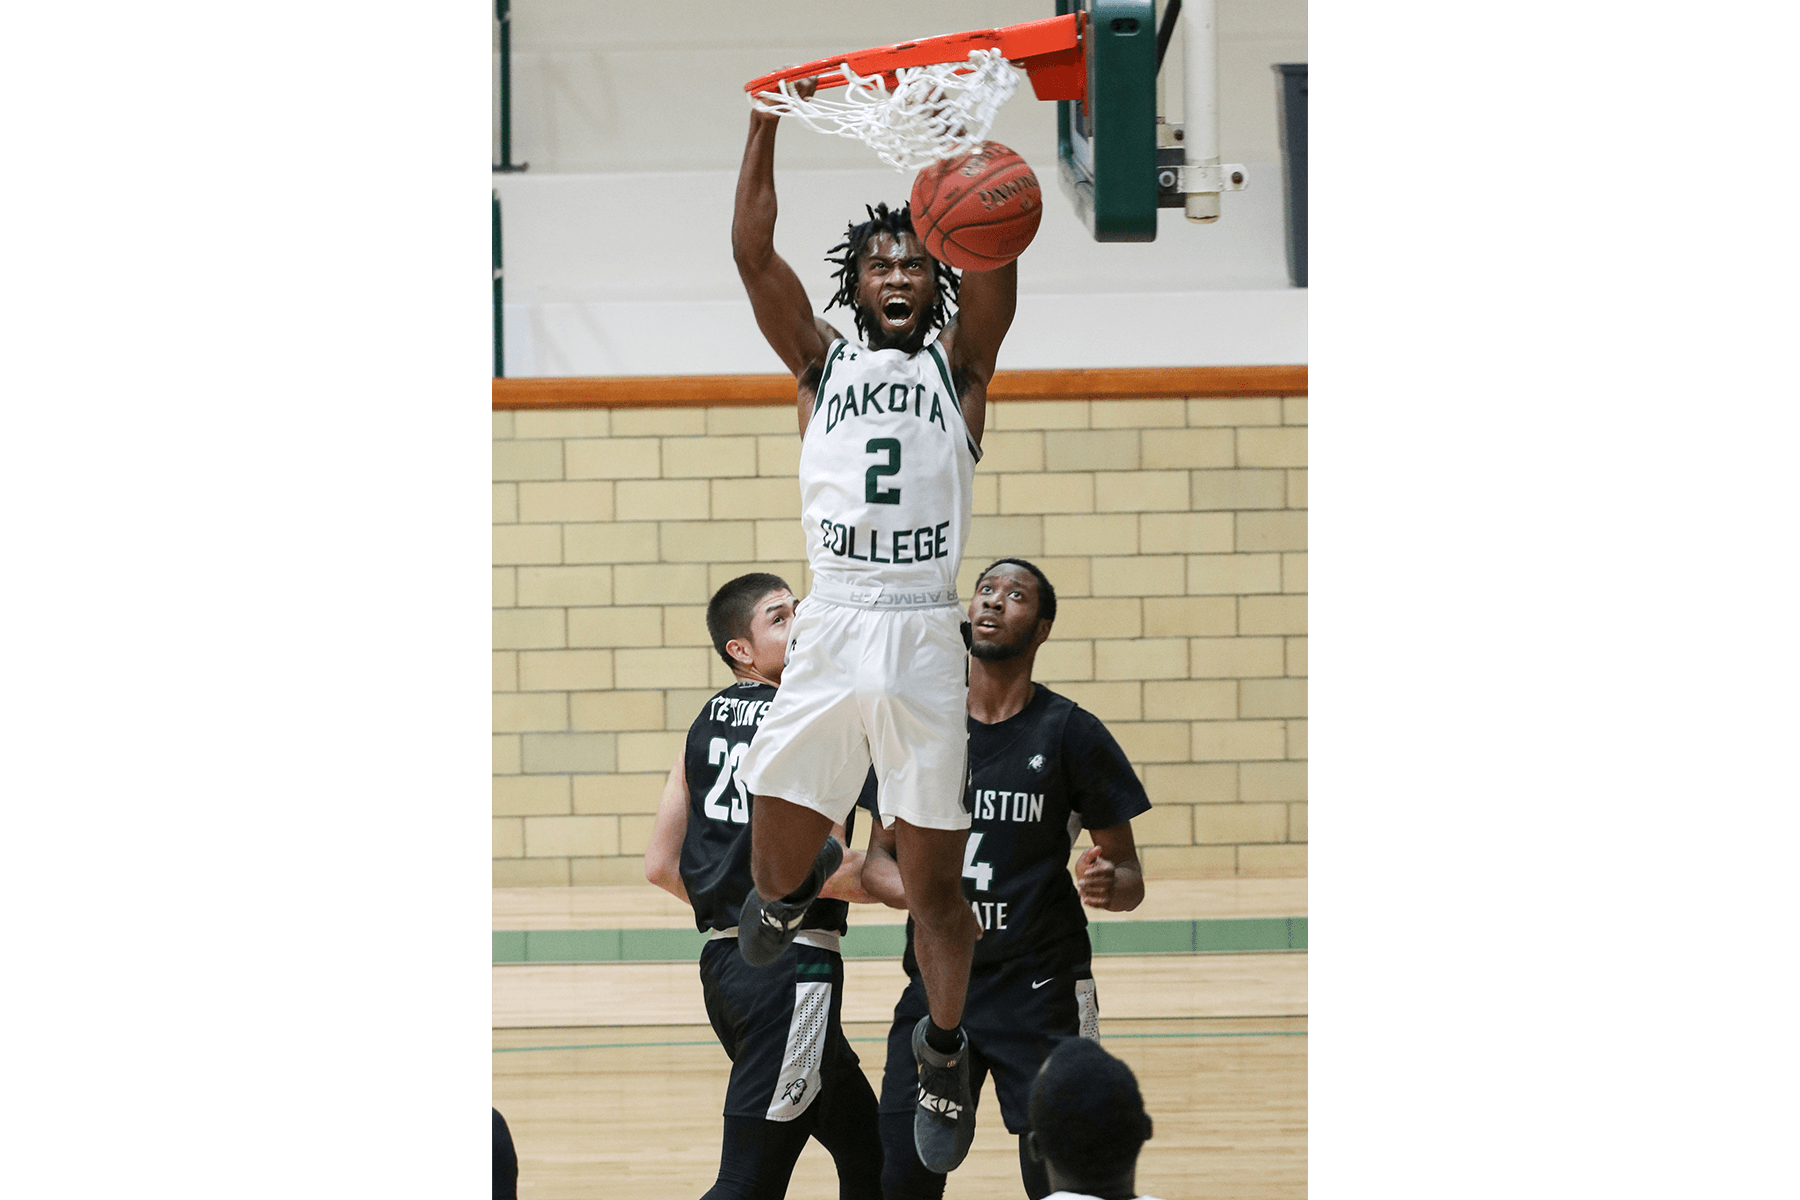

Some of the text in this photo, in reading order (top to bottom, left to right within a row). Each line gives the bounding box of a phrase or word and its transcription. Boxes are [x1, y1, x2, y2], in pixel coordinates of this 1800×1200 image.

[826, 382, 947, 434] DAKOTA
[865, 437, 901, 505] 2
[820, 518, 950, 564] COLLEGE
[850, 590, 941, 605] ARMOR
[709, 696, 774, 727] TETONS
[704, 737, 750, 824] 23
[974, 789, 1045, 823] ISTON
[961, 832, 993, 891] 4
[971, 901, 1007, 930] ATE
